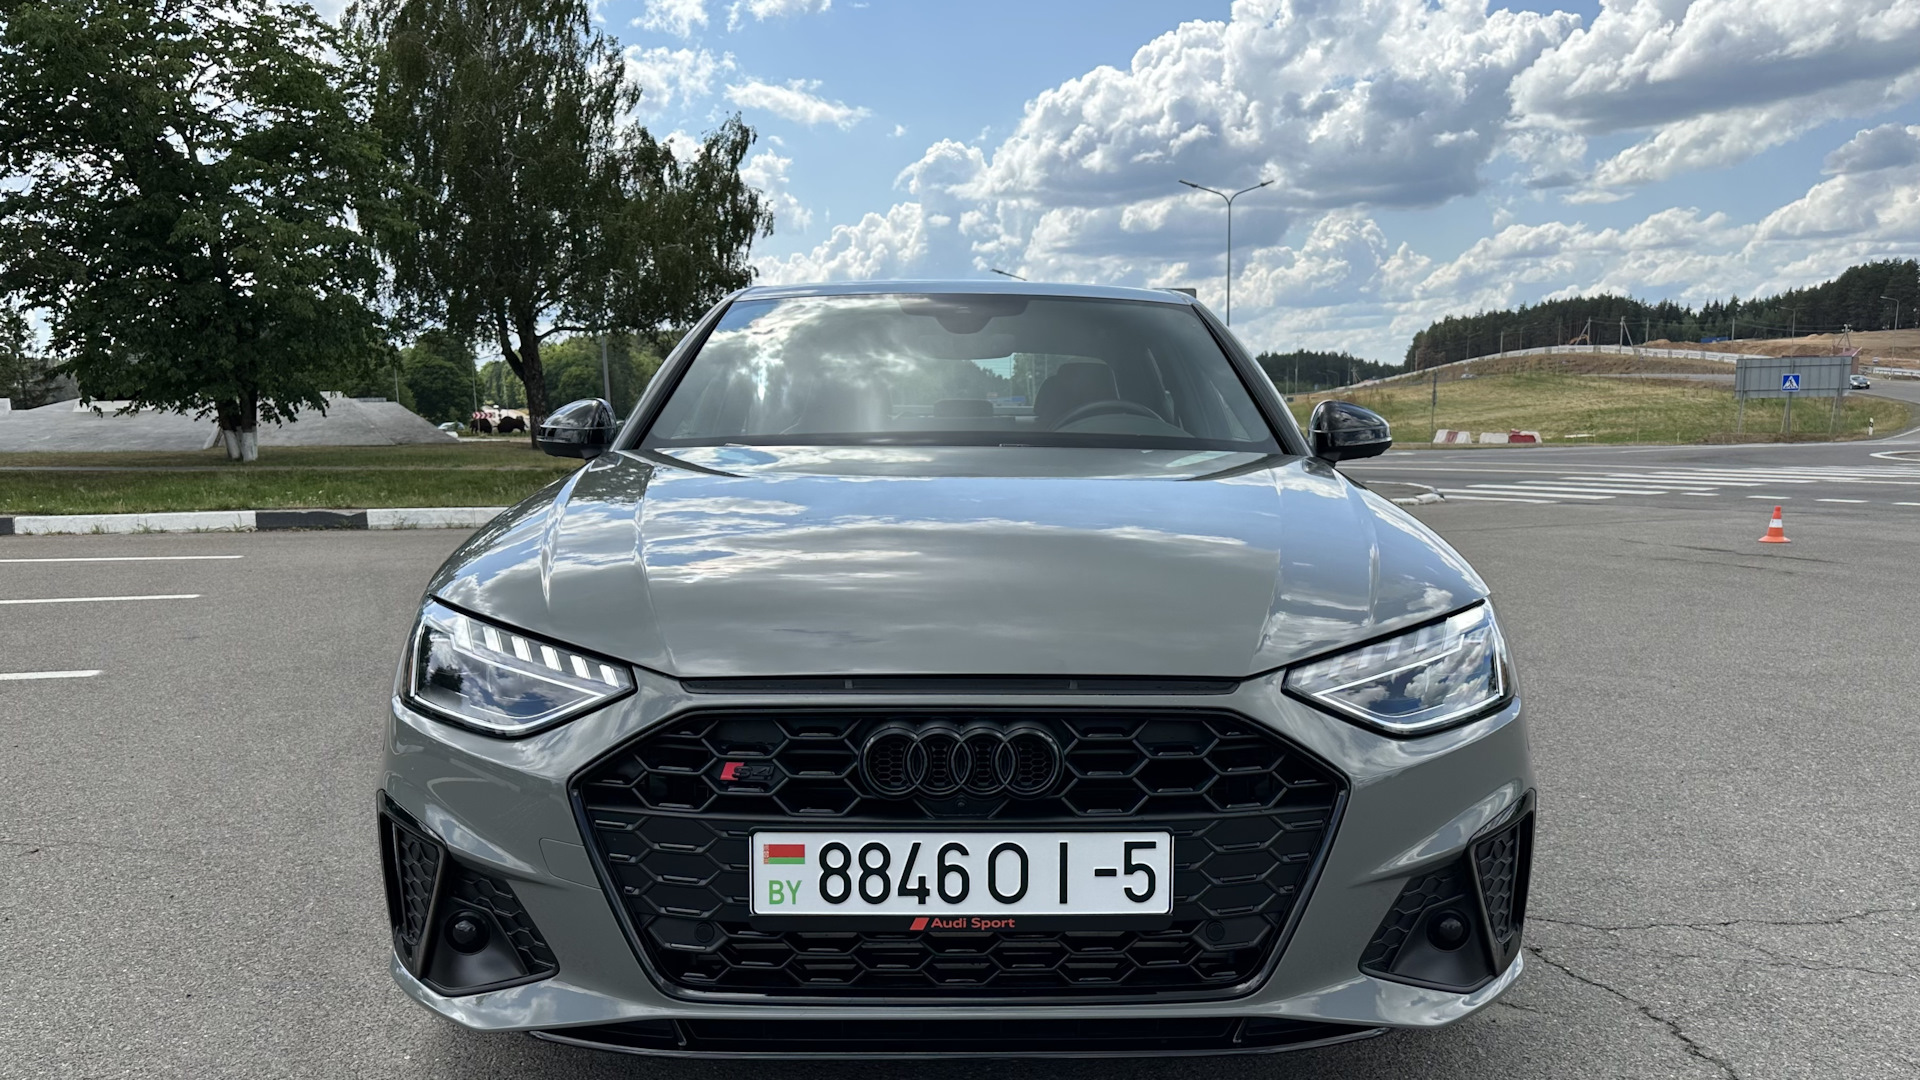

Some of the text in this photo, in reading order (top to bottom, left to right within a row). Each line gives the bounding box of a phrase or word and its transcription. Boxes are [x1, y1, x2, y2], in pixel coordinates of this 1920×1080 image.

[768, 879, 802, 906] BY
[931, 917, 1016, 931] Audi Sport
